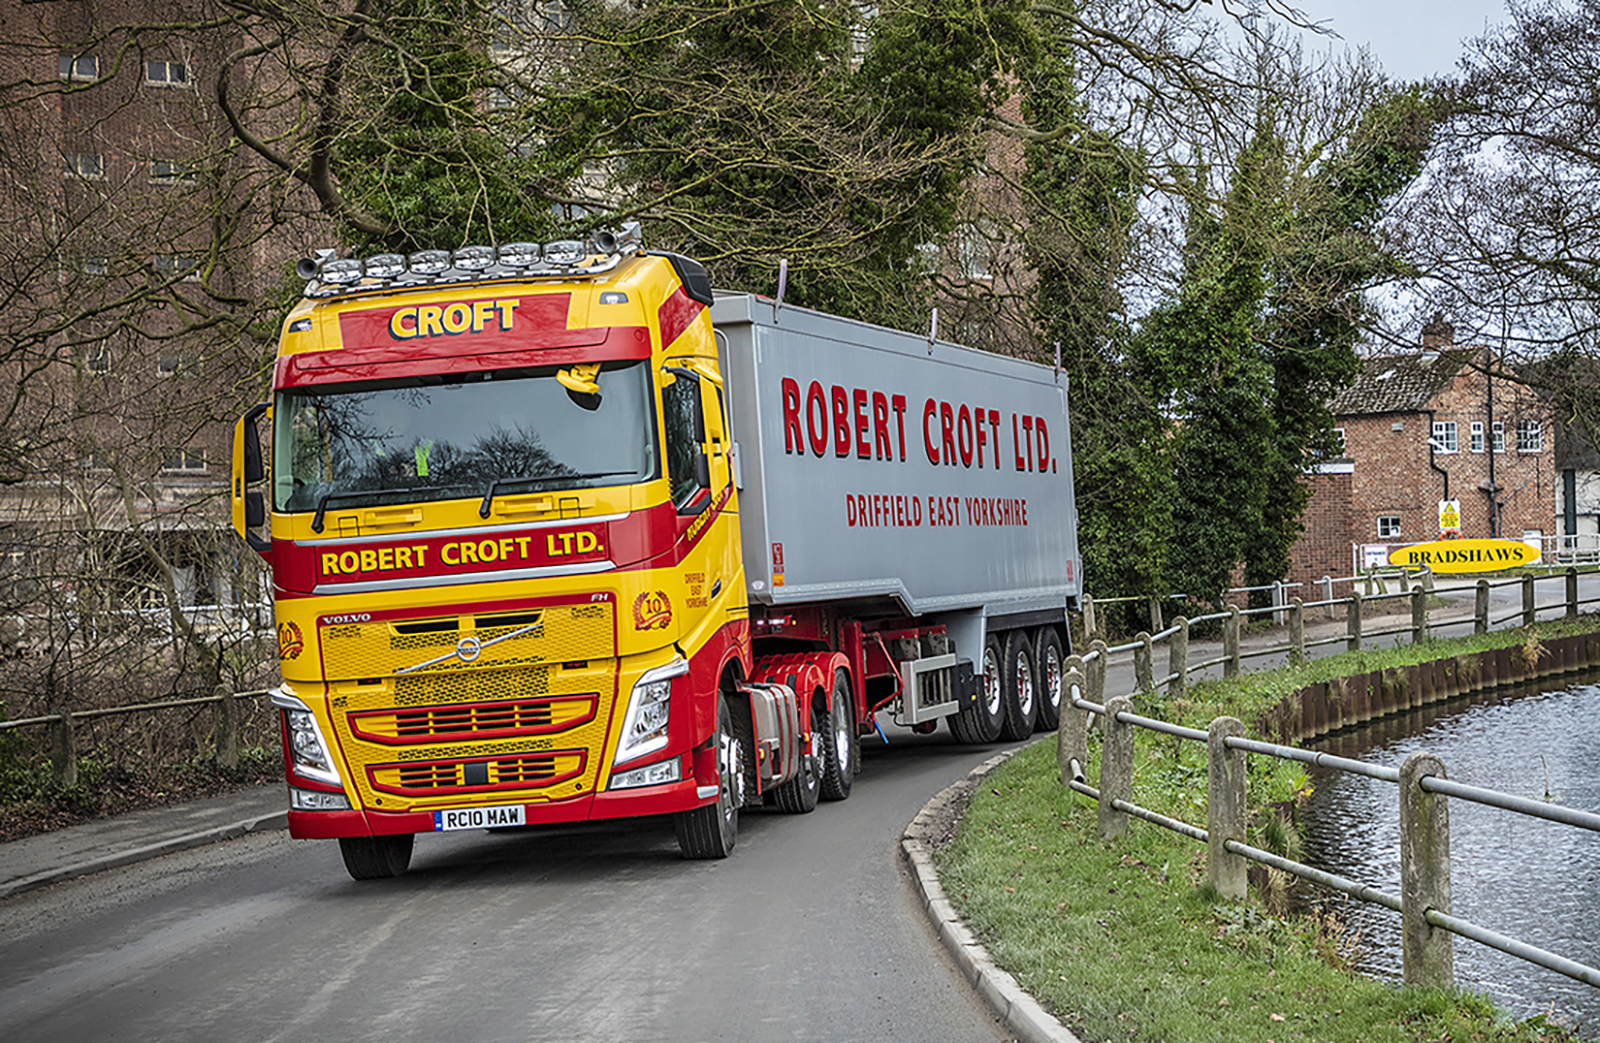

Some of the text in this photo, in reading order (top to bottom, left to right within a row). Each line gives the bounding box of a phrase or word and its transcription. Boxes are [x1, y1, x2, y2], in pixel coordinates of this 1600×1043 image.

[388, 299, 520, 341] CROFT
[782, 377, 1057, 474] ROBERT CROFT LTD.
[846, 494, 1028, 527] DRIFFIELD EAST YORKSHIRE
[321, 531, 604, 575] ROBERT CROFT LTD.
[1409, 548, 1524, 564] BRADSHAWS
[590, 593, 608, 602] FH
[645, 598, 662, 614] 10
[322, 613, 371, 625] VOLVO
[447, 808, 518, 828] RC10 MAW
